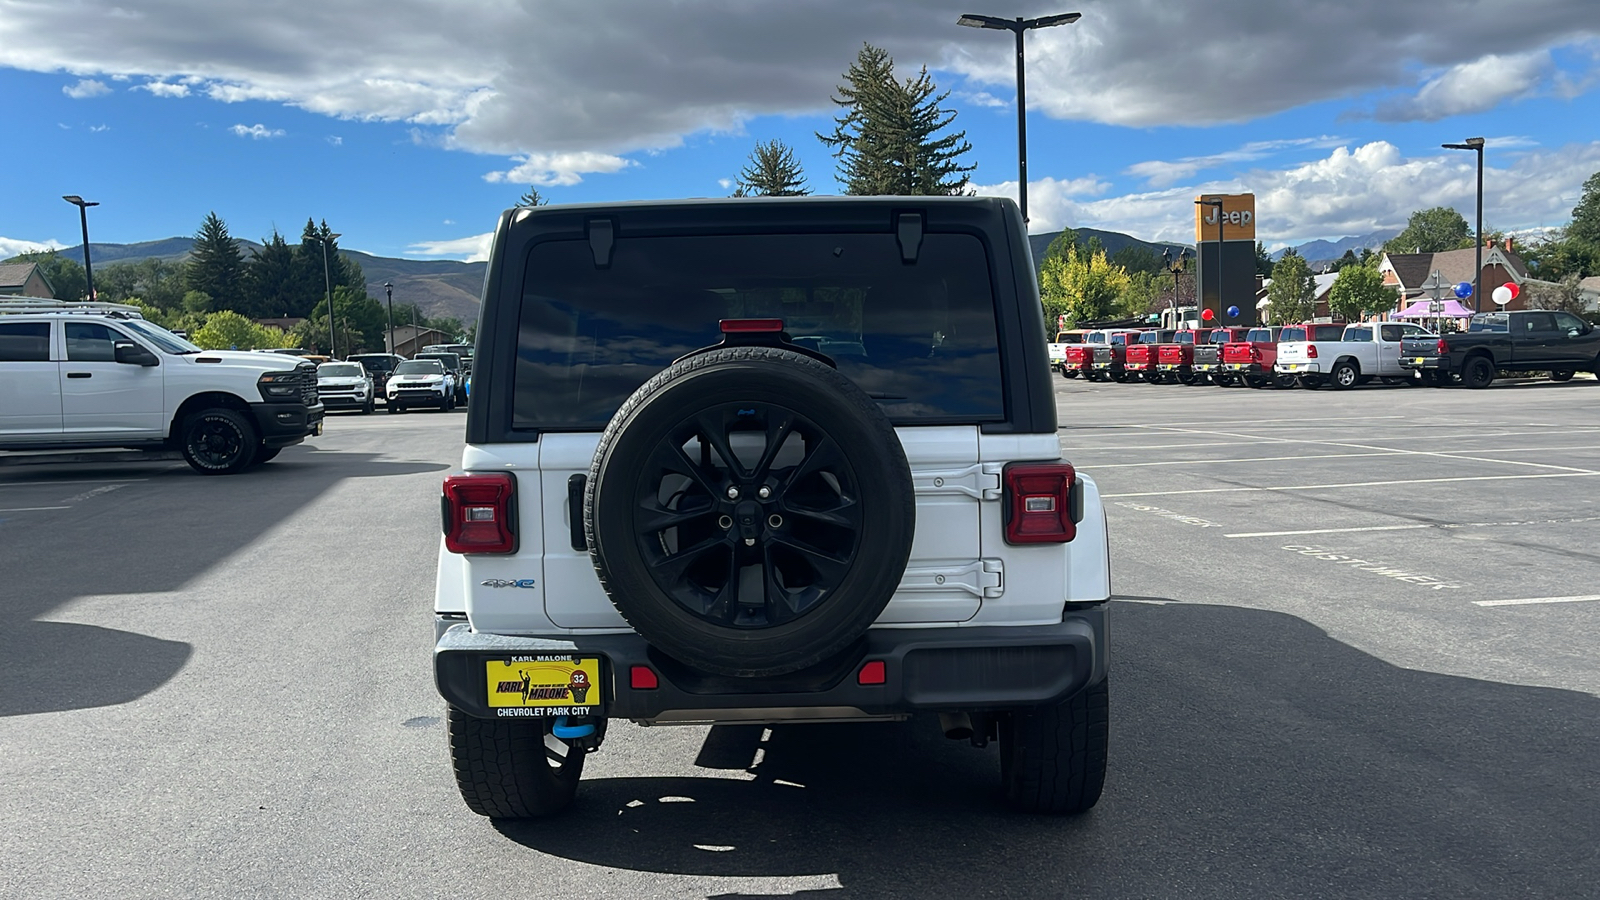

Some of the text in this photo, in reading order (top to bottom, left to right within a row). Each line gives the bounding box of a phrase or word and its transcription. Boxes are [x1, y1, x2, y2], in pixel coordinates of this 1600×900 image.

[1205, 207, 1252, 227] Jeep
[573, 674, 585, 683] 32
[496, 681, 523, 693] KARL
[528, 687, 570, 700] MALONE
[497, 706, 590, 717] CHEVROLET PARK CITY
